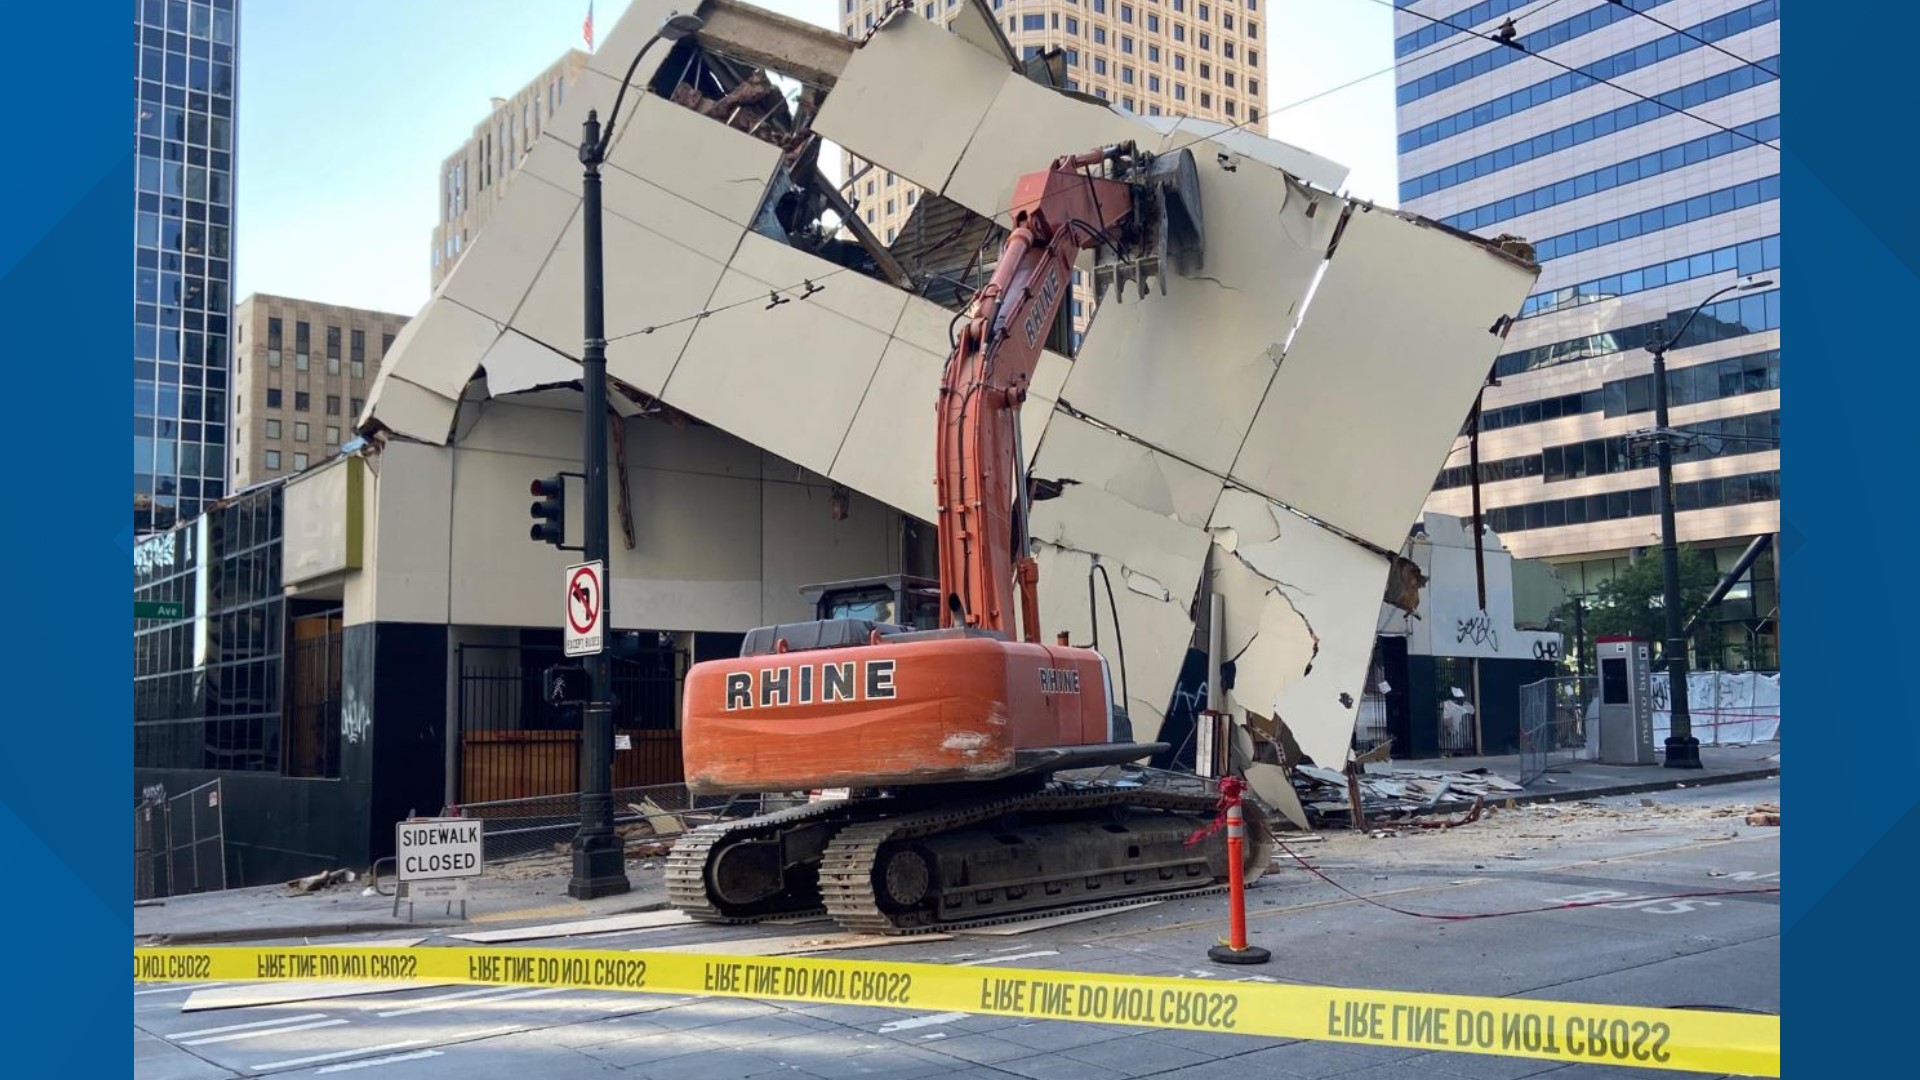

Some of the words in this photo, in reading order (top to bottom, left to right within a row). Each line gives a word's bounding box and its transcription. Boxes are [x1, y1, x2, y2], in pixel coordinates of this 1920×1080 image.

[1025, 265, 1059, 350] RHINE
[158, 606, 177, 617] Ave
[724, 659, 898, 712] RHINE
[1038, 667, 1080, 694] RHINE
[1639, 664, 1647, 692] bus
[1640, 697, 1650, 744] metro
[402, 826, 478, 847] SIDEWALK
[405, 852, 475, 873] CLOSED
